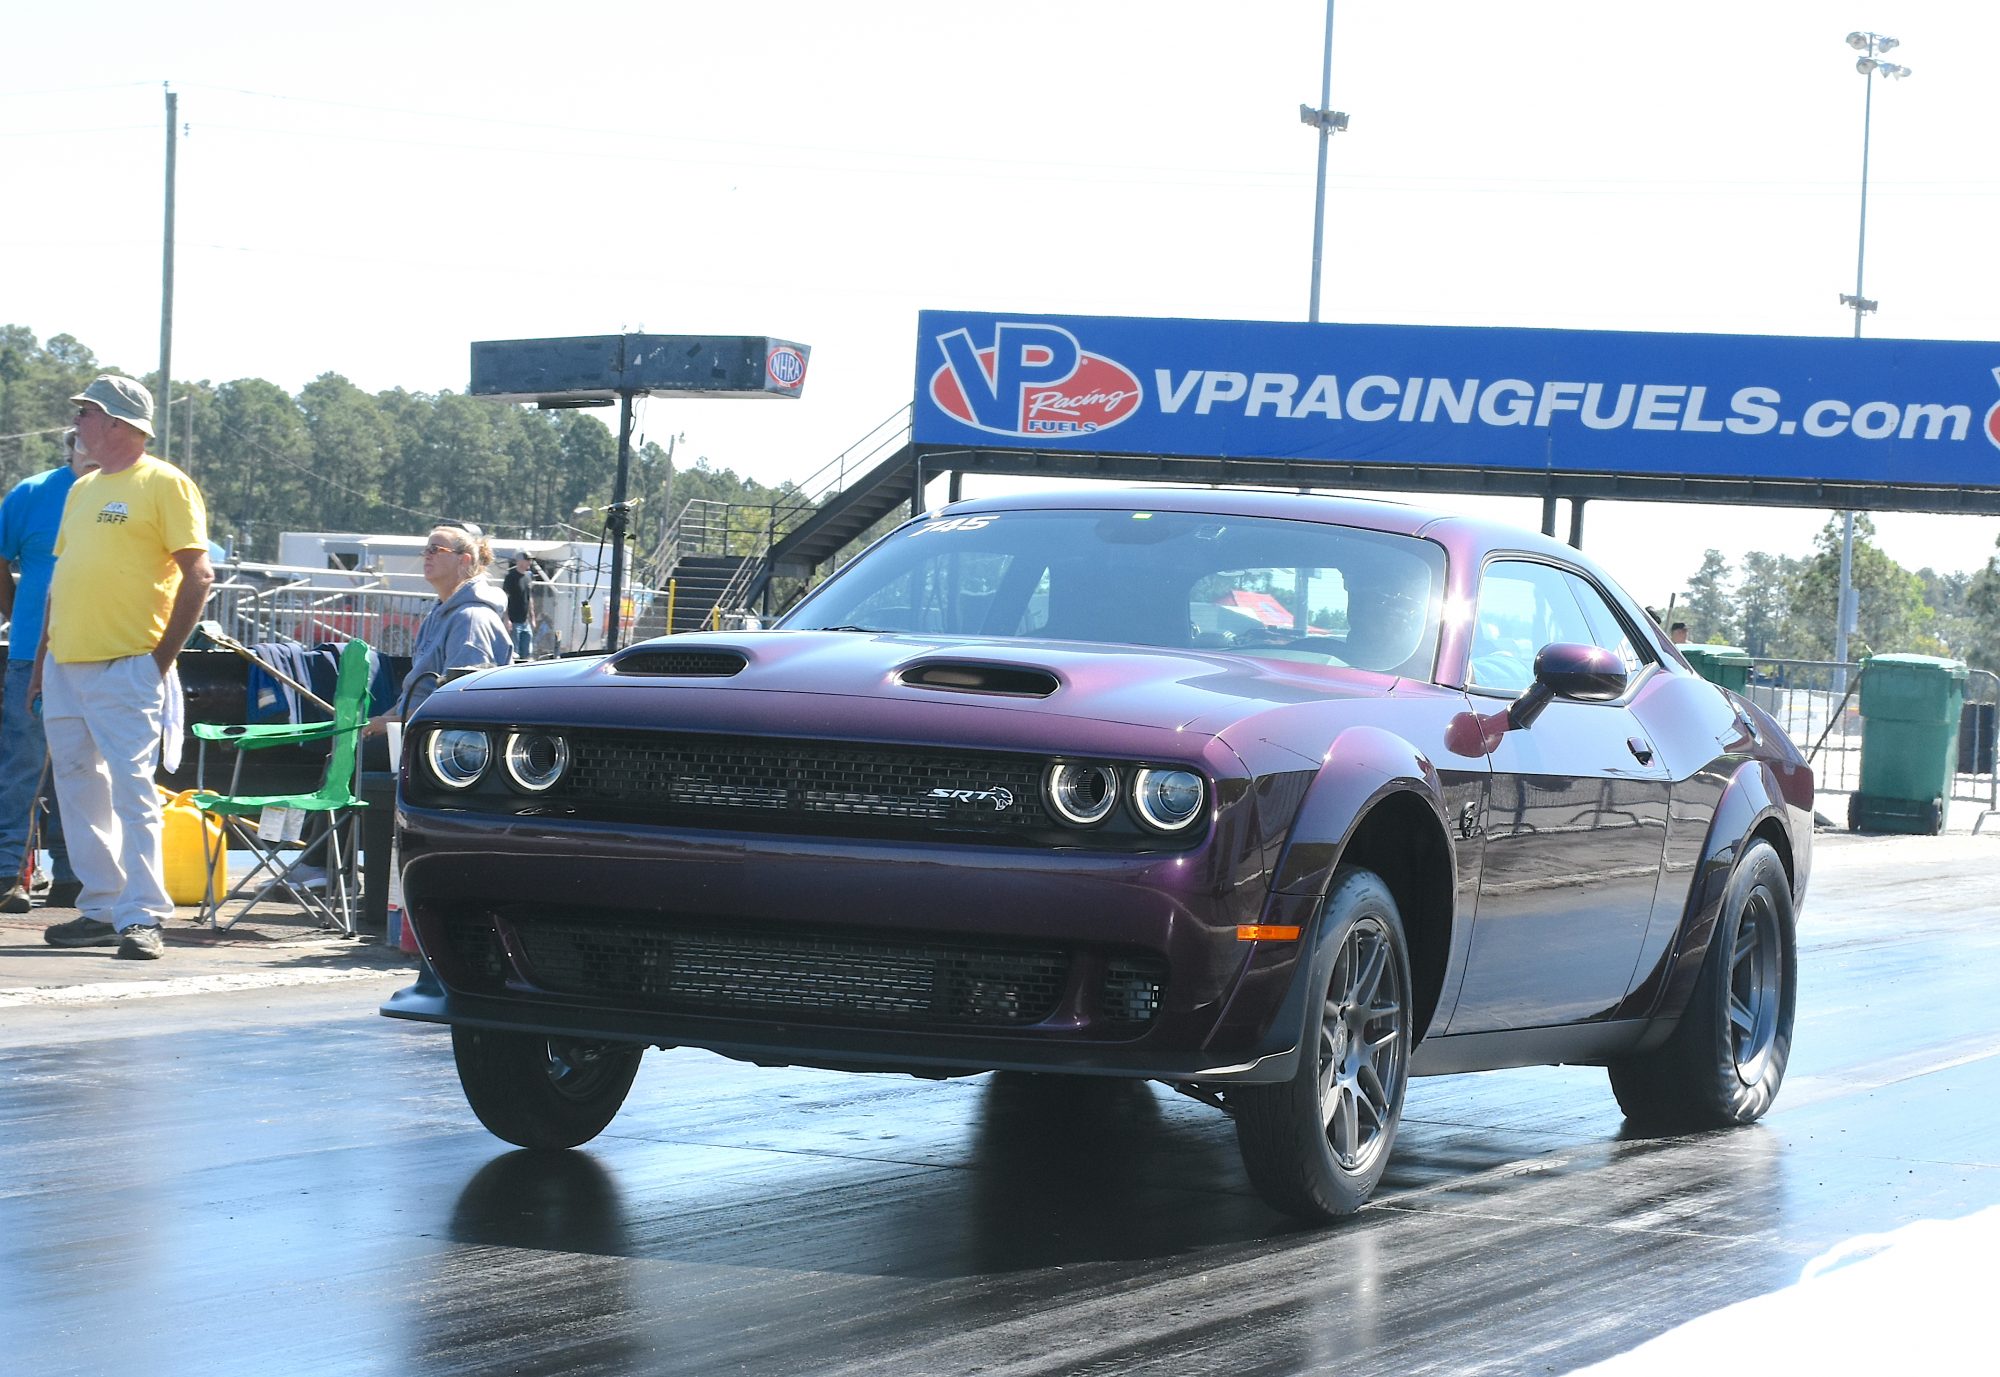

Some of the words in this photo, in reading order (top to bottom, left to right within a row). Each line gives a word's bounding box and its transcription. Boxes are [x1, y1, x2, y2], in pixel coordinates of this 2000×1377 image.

[772, 353, 801, 381] NHRA
[936, 322, 1081, 434] VP
[1028, 388, 1139, 418] Racing
[1154, 369, 1972, 441] VPRACINGFUELS.com
[1027, 419, 1098, 433] FUELS
[97, 512, 128, 525] STAFF
[907, 515, 1001, 538] 745
[927, 788, 996, 803] SRT
